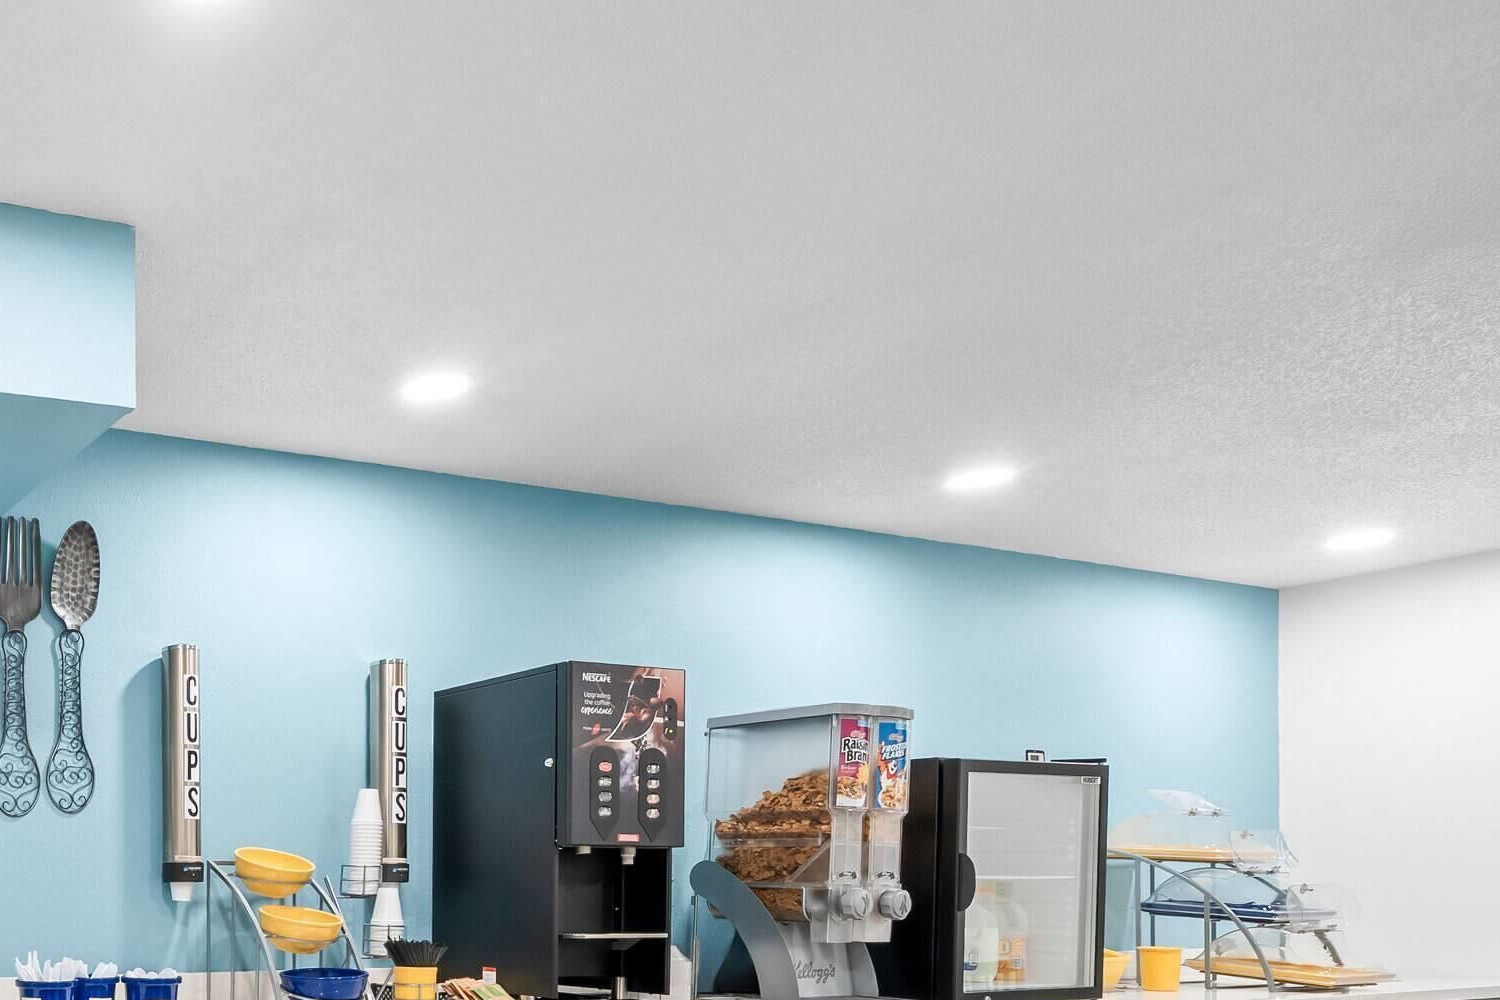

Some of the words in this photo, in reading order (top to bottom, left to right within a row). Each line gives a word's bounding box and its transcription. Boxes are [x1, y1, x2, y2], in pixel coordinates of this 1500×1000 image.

[583, 691, 611, 700] Upgrading
[186, 675, 199, 818] CUPS
[394, 686, 406, 822] CUPS
[846, 749, 868, 762] Bran
[882, 749, 906, 760] FLAKES
